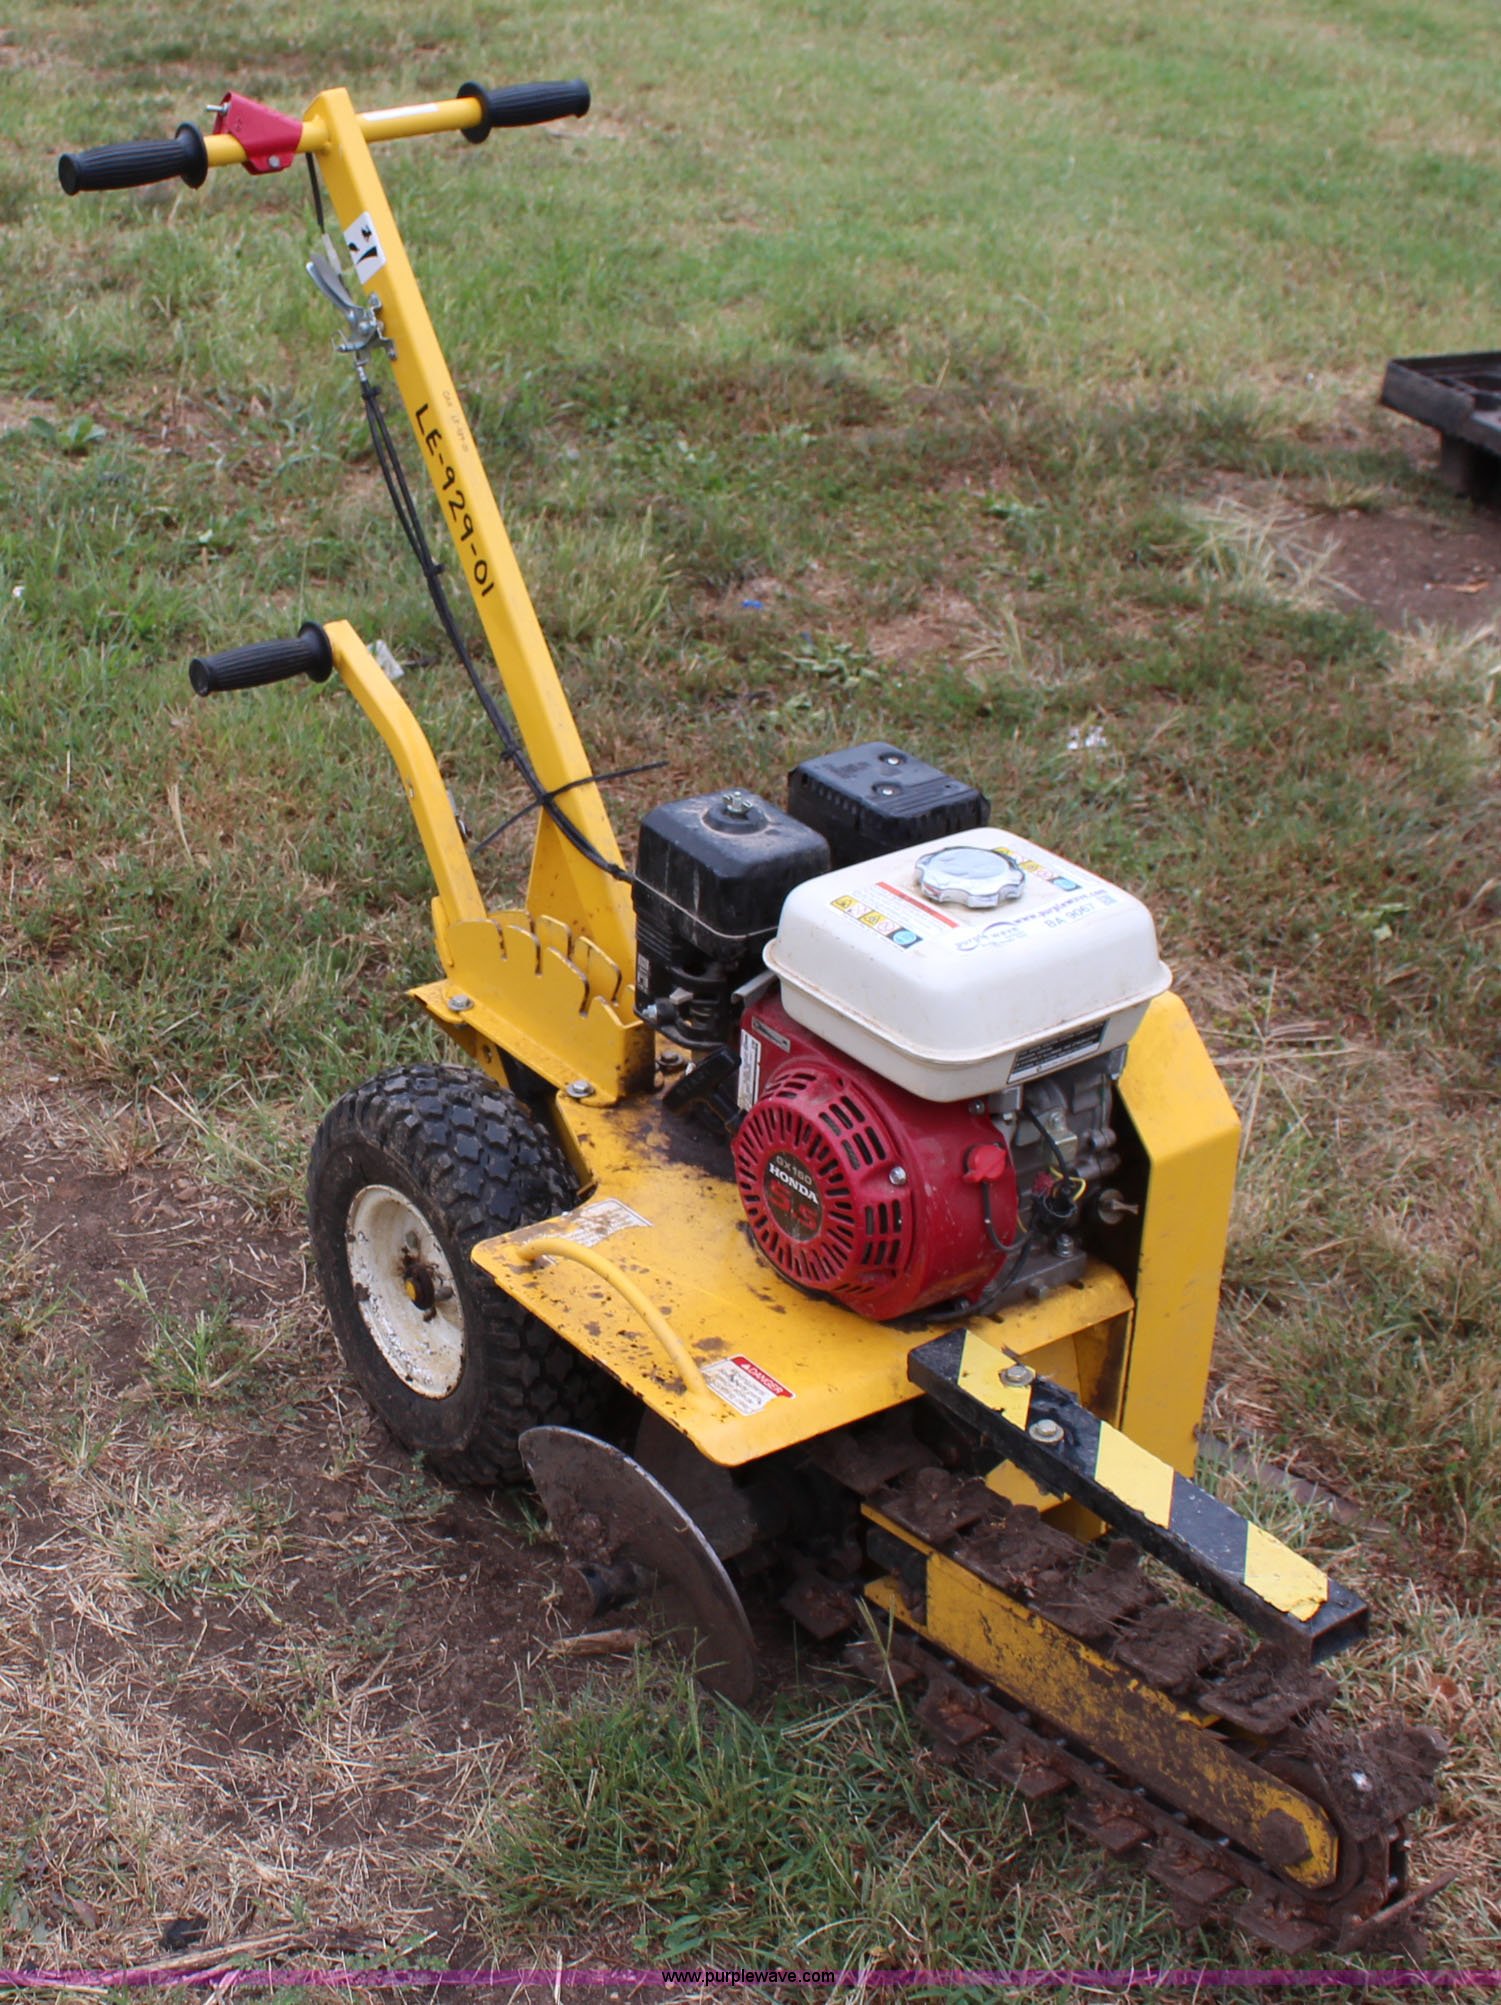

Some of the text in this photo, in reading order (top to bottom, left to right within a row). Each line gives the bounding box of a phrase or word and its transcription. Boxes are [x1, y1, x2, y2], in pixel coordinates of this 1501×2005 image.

[415, 404, 495, 597] LE-929-01
[768, 1162, 819, 1205] HONDA
[775, 1155, 812, 1186] GX160
[767, 1179, 819, 1230] 5.5
[747, 1366, 784, 1395] DANGER
